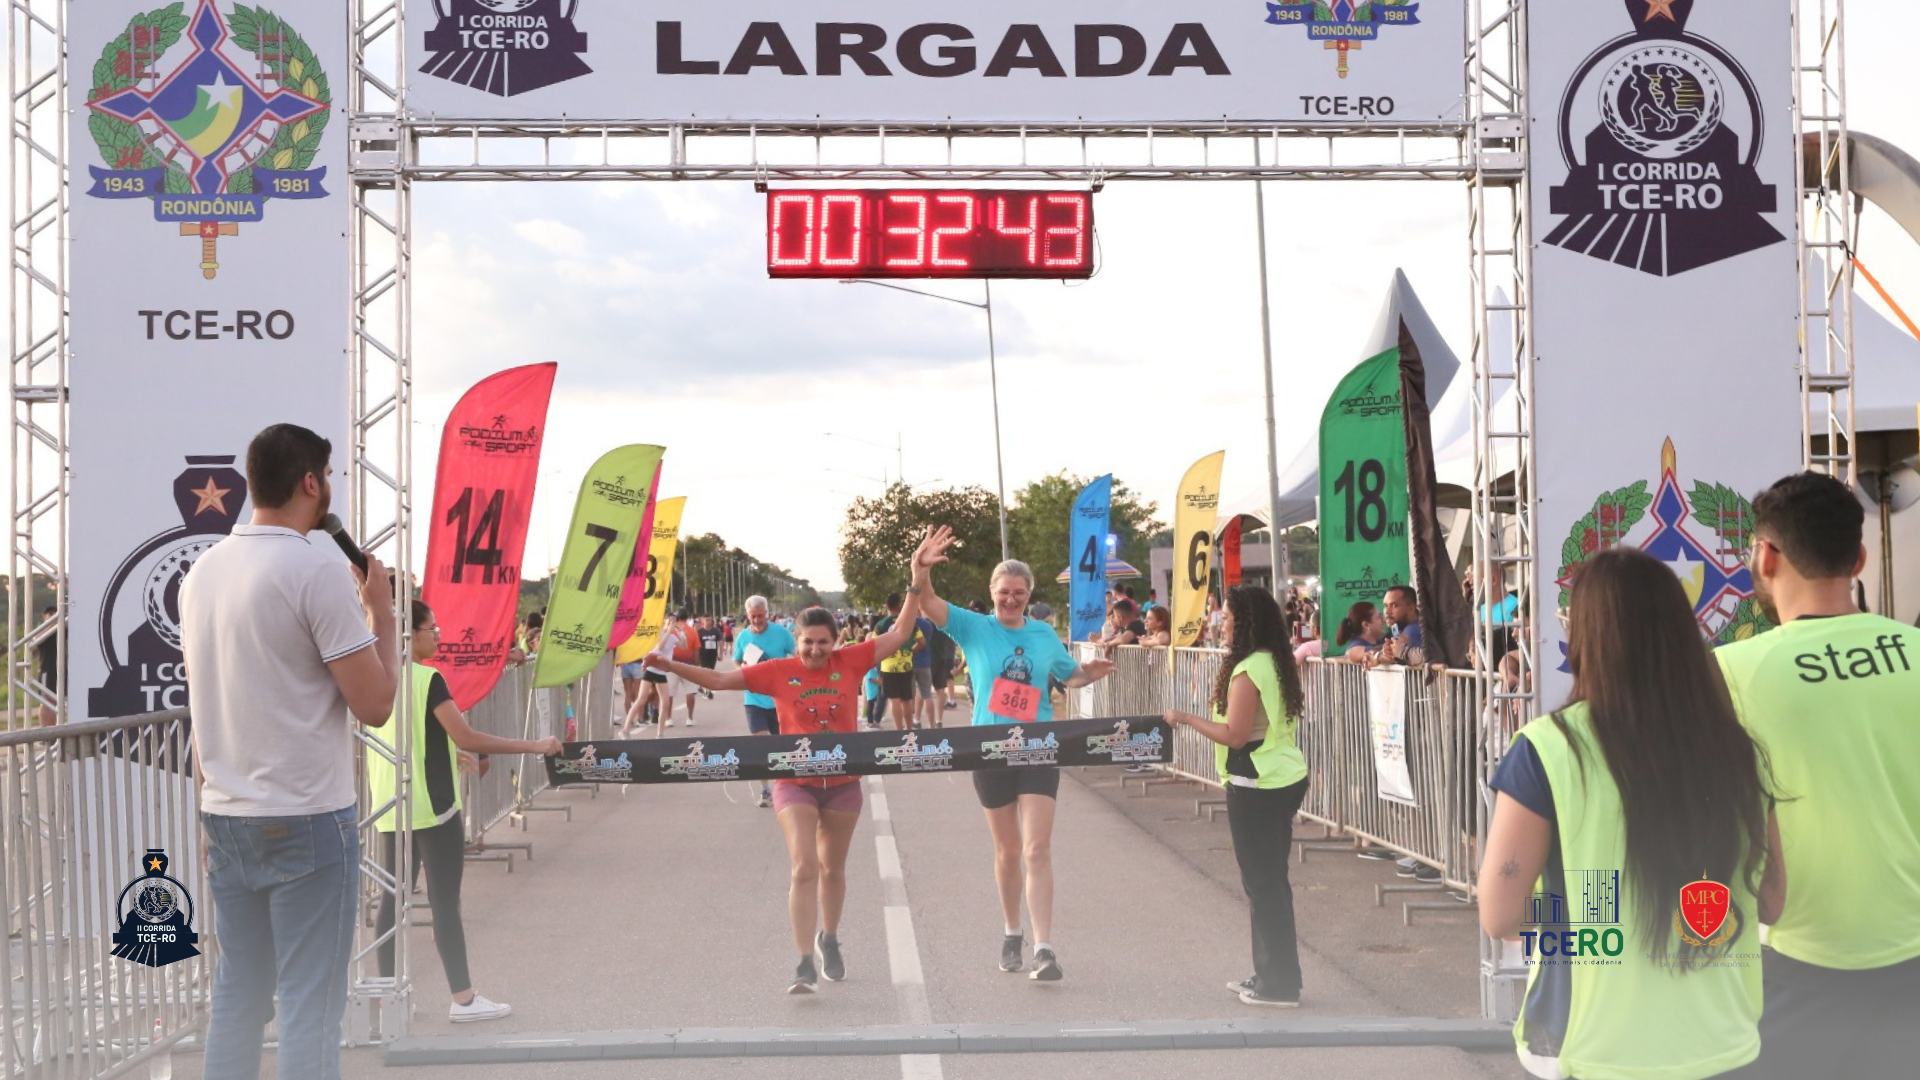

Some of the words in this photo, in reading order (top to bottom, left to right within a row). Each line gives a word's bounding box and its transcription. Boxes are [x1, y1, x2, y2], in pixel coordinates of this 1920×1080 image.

[459, 16, 465, 28] I
[470, 15, 548, 29] CORRIDA
[1276, 11, 1302, 20] 1943
[1384, 11, 1408, 21] 1981
[1312, 25, 1373, 36] RONDÔNIA
[458, 30, 550, 50] TCE-RO
[656, 21, 1232, 77] LARGADA
[1299, 96, 1395, 116] TCE-RO
[1598, 163, 1605, 181] I
[1612, 161, 1721, 182] CORRIDA
[103, 178, 145, 193] 1943
[273, 178, 311, 193] 1981
[1597, 183, 1724, 211] TCE-RO
[161, 198, 256, 217] RONDÔNIA
[138, 309, 295, 341] TCE-RO
[460, 427, 523, 441] PODIUM
[485, 442, 536, 453] SPORT
[593, 480, 635, 496] PODIUM
[608, 494, 642, 507] SPORT
[1334, 459, 1387, 543] 18
[1387, 522, 1404, 538] KM
[446, 487, 505, 585] 14
[578, 523, 618, 592] 7
[1079, 535, 1097, 581] 4
[1188, 530, 1209, 591] 6
[1335, 579, 1388, 590] PODIUM
[1359, 590, 1385, 600] SPO
[550, 630, 593, 645] PODIUM
[437, 643, 492, 653] ODIUM
[567, 642, 602, 654] SPORT
[454, 655, 502, 666] SPORT
[1794, 634, 1911, 684] staff
[1001, 693, 1028, 710] 368
